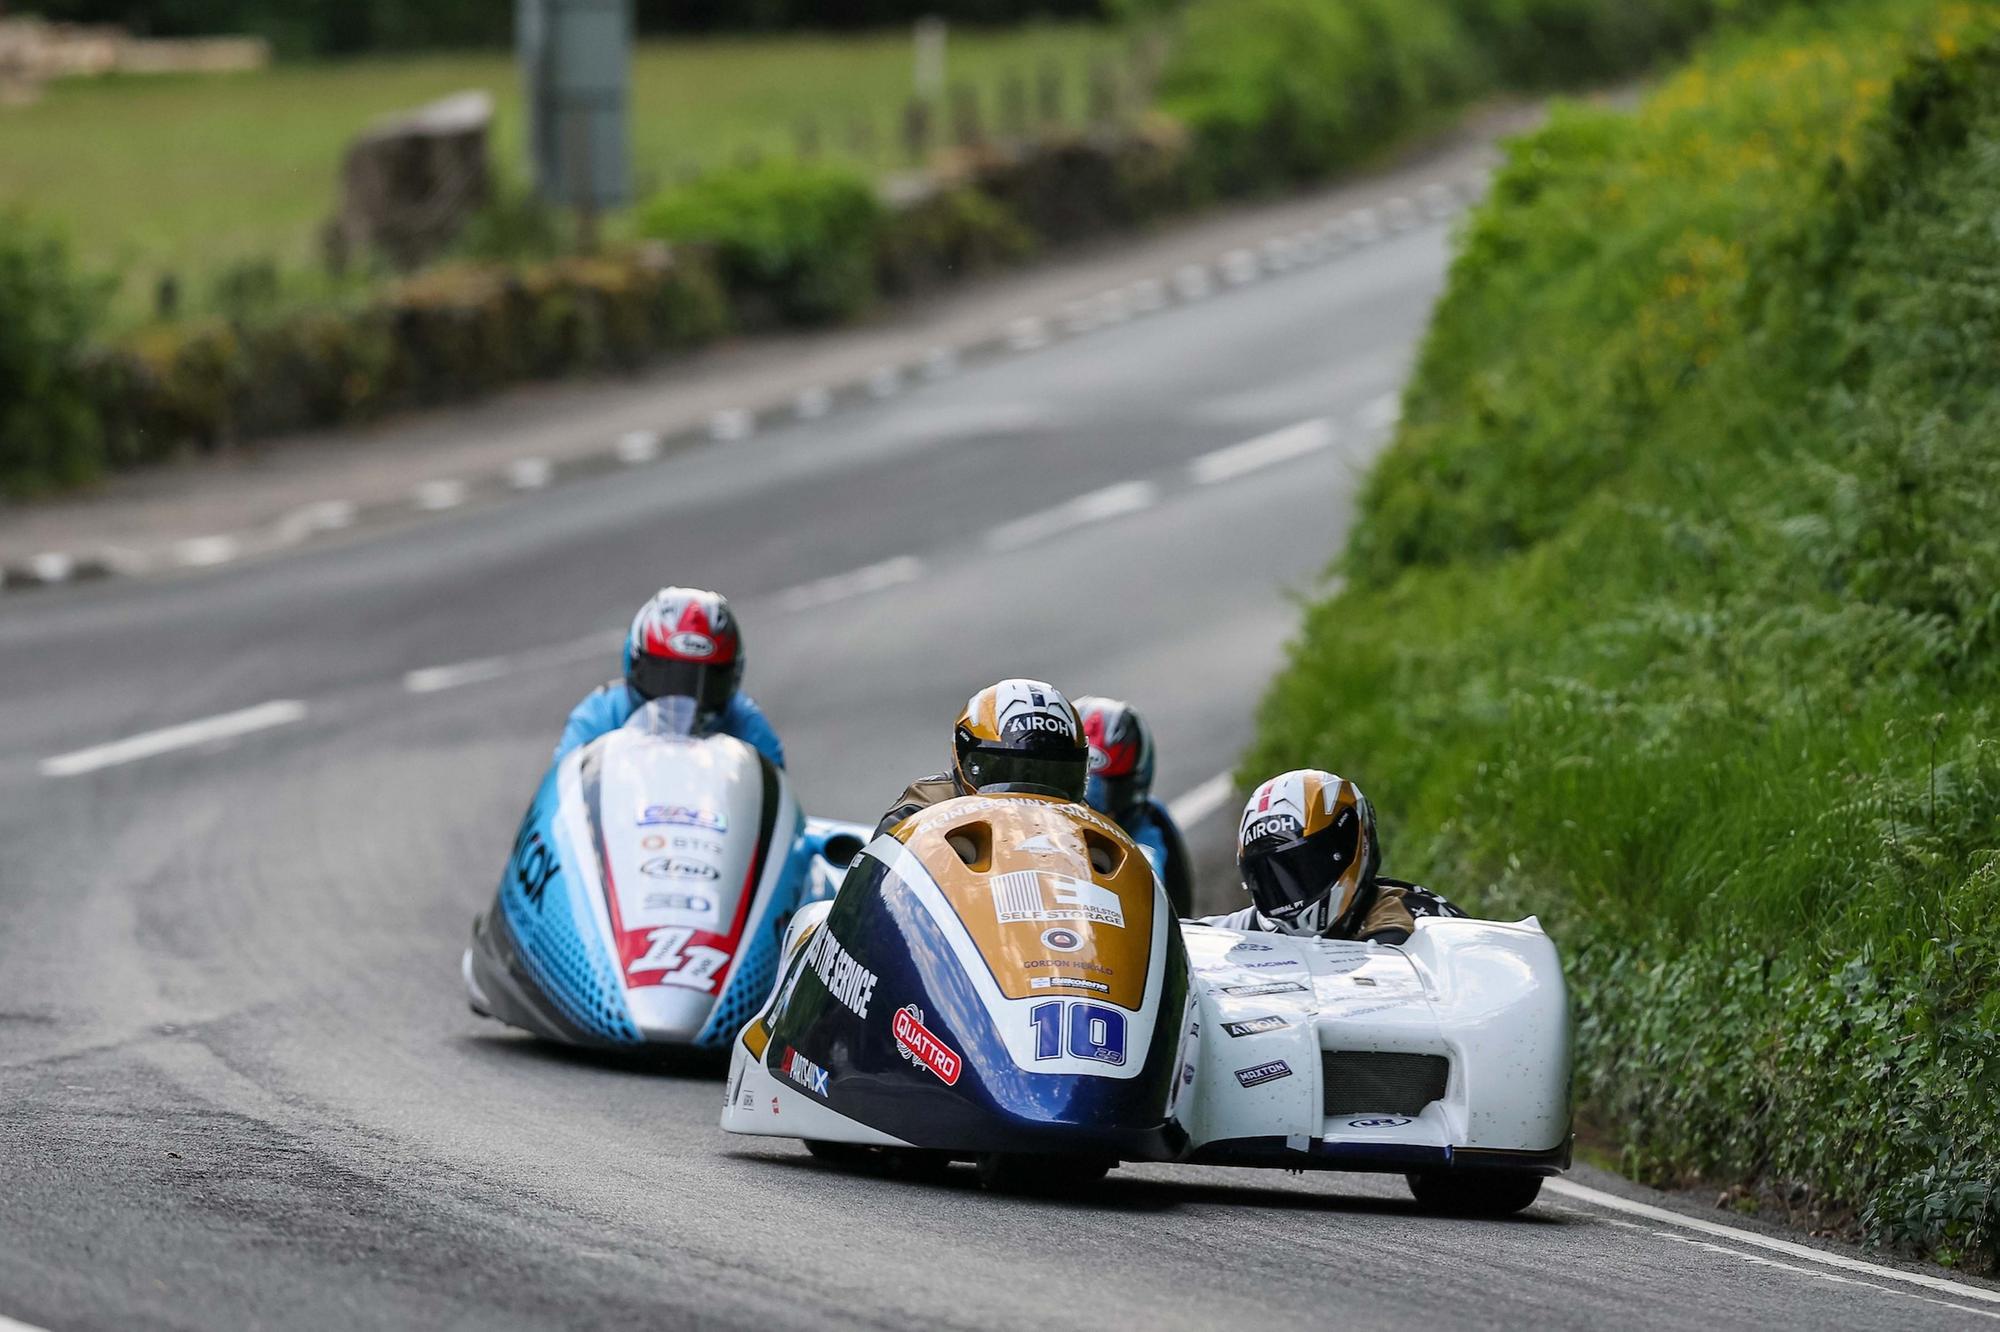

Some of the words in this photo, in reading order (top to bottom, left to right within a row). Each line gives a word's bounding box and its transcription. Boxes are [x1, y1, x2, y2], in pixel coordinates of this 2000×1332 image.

[1010, 716, 1069, 738] AIROH
[1245, 816, 1296, 846] AIROH
[1001, 911, 1043, 921] SELF
[1047, 910, 1121, 924] STORAGE
[1023, 960, 1070, 968] GORDON
[828, 948, 879, 1020] SERVICE
[1030, 1001, 1128, 1067] 10
[1230, 1016, 1282, 1036] AIROH
[896, 1012, 956, 1077] QUATTRO
[1239, 1062, 1286, 1082] MAXTON
